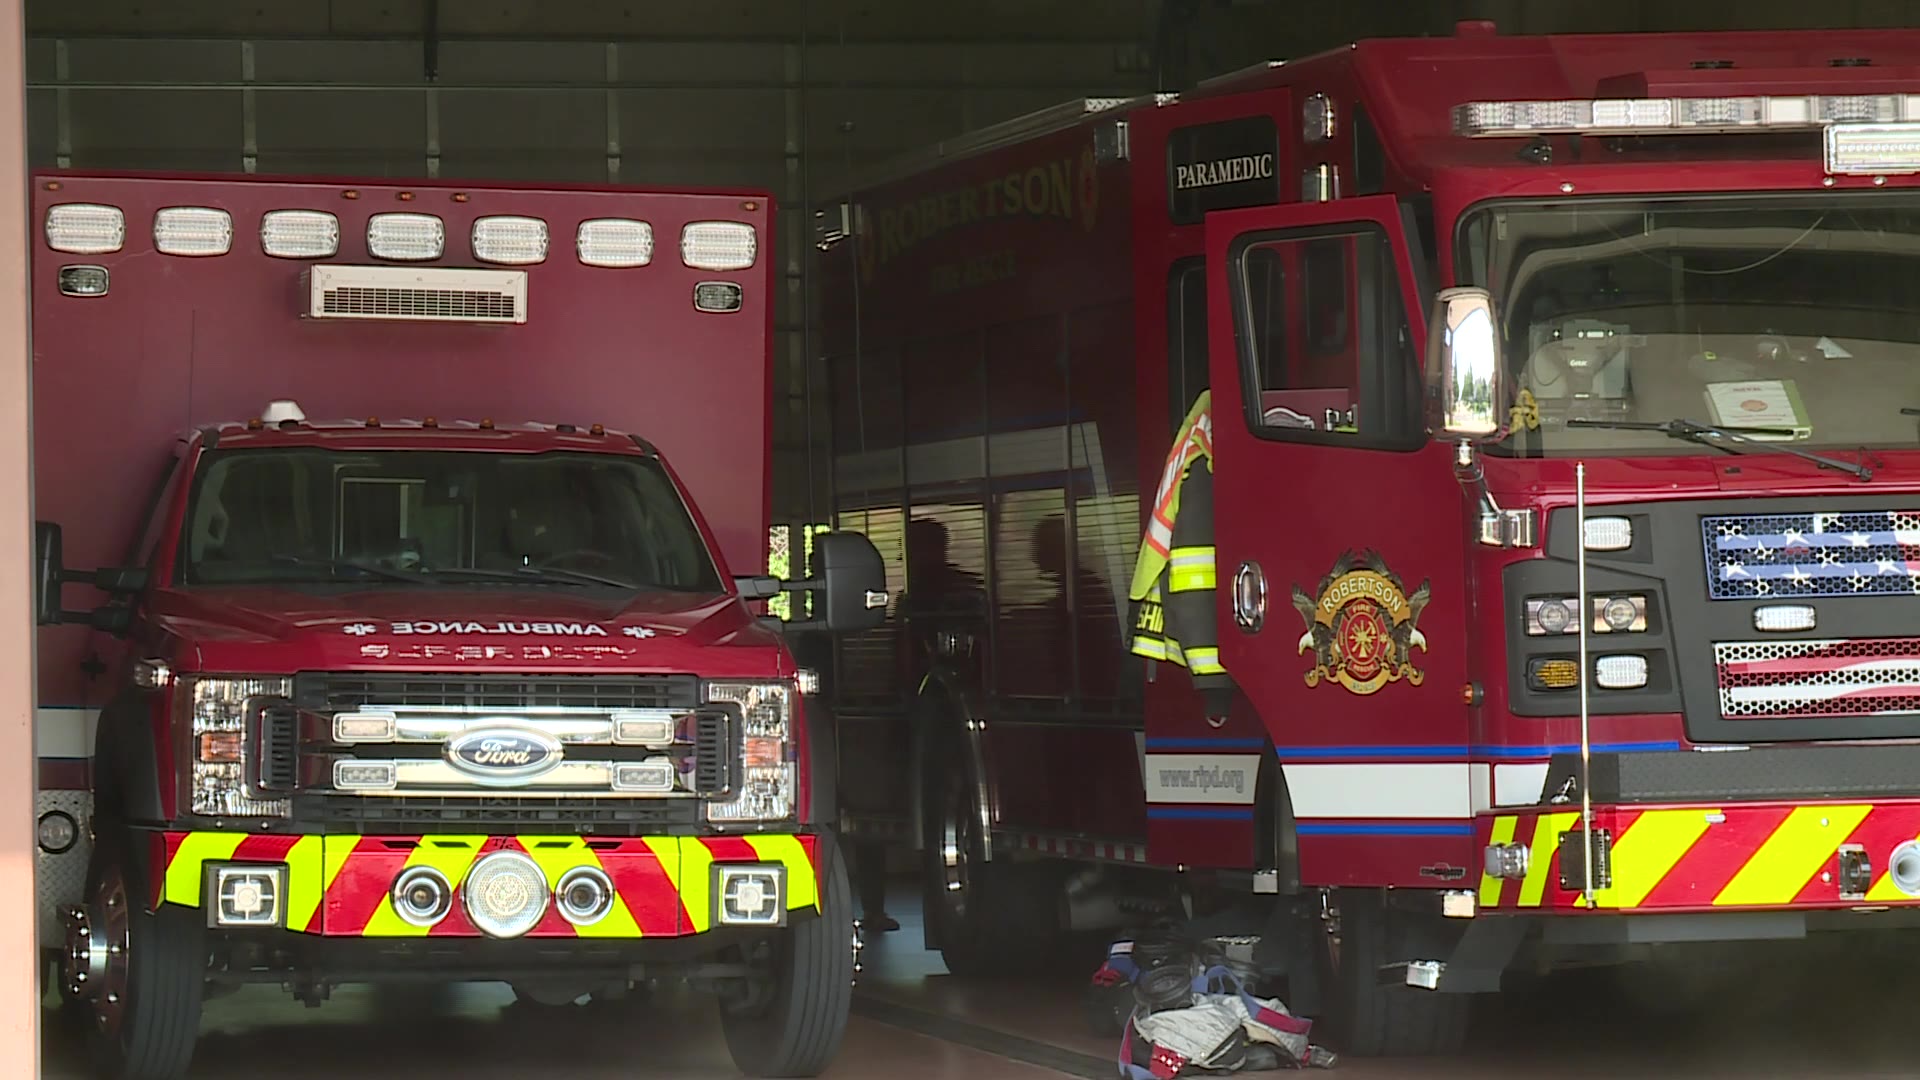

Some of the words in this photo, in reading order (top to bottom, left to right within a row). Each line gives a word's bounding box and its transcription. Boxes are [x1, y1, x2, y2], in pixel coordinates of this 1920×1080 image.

[1176, 153, 1273, 189] PARAMEDIC
[880, 159, 1073, 264] ROBERTSON
[1322, 577, 1402, 613] ROBERTSON
[474, 739, 532, 764] Ford
